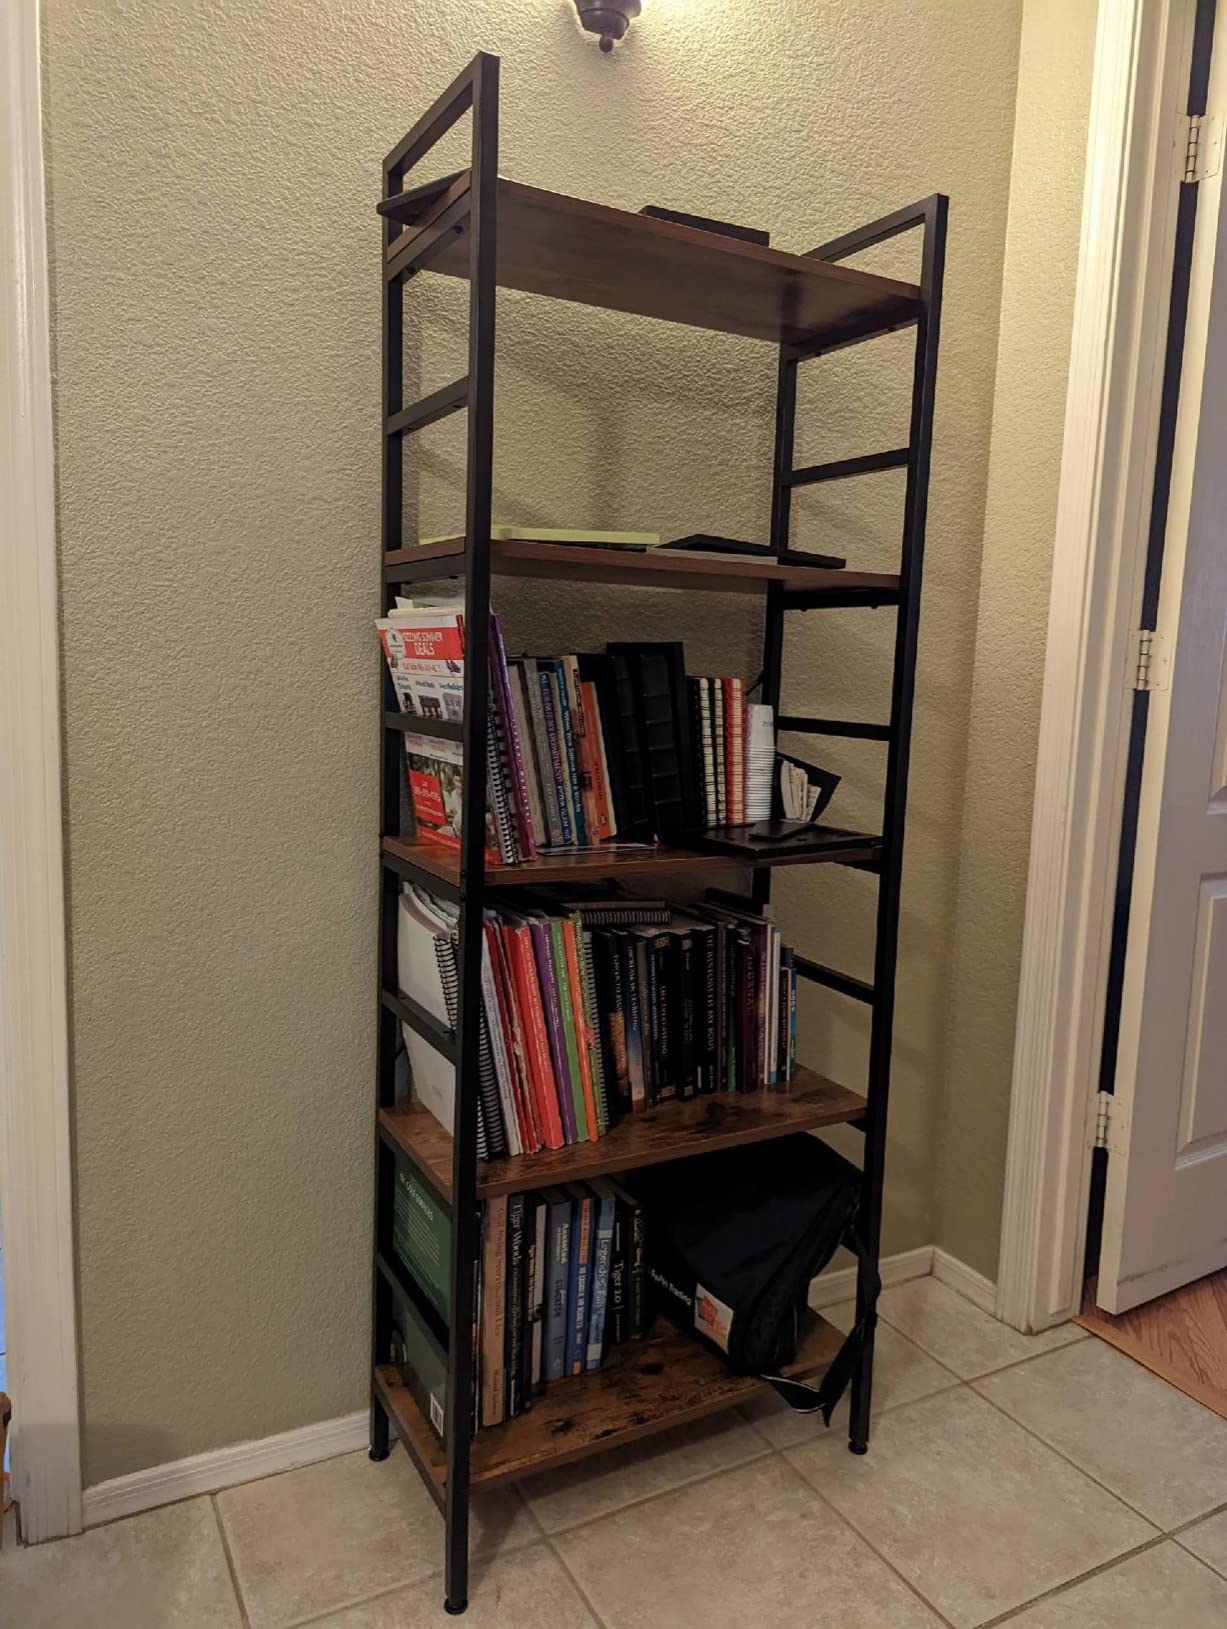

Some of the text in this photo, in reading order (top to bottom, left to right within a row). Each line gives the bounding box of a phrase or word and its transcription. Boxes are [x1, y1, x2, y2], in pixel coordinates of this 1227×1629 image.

[414, 642, 435, 656] DEALS
[495, 1208, 505, 1227] Golf
[511, 1204, 523, 1229] Tiger
[512, 1231, 523, 1265] Woods
[599, 1239, 610, 1277] Legends
[611, 1260, 625, 1287] Tiger
